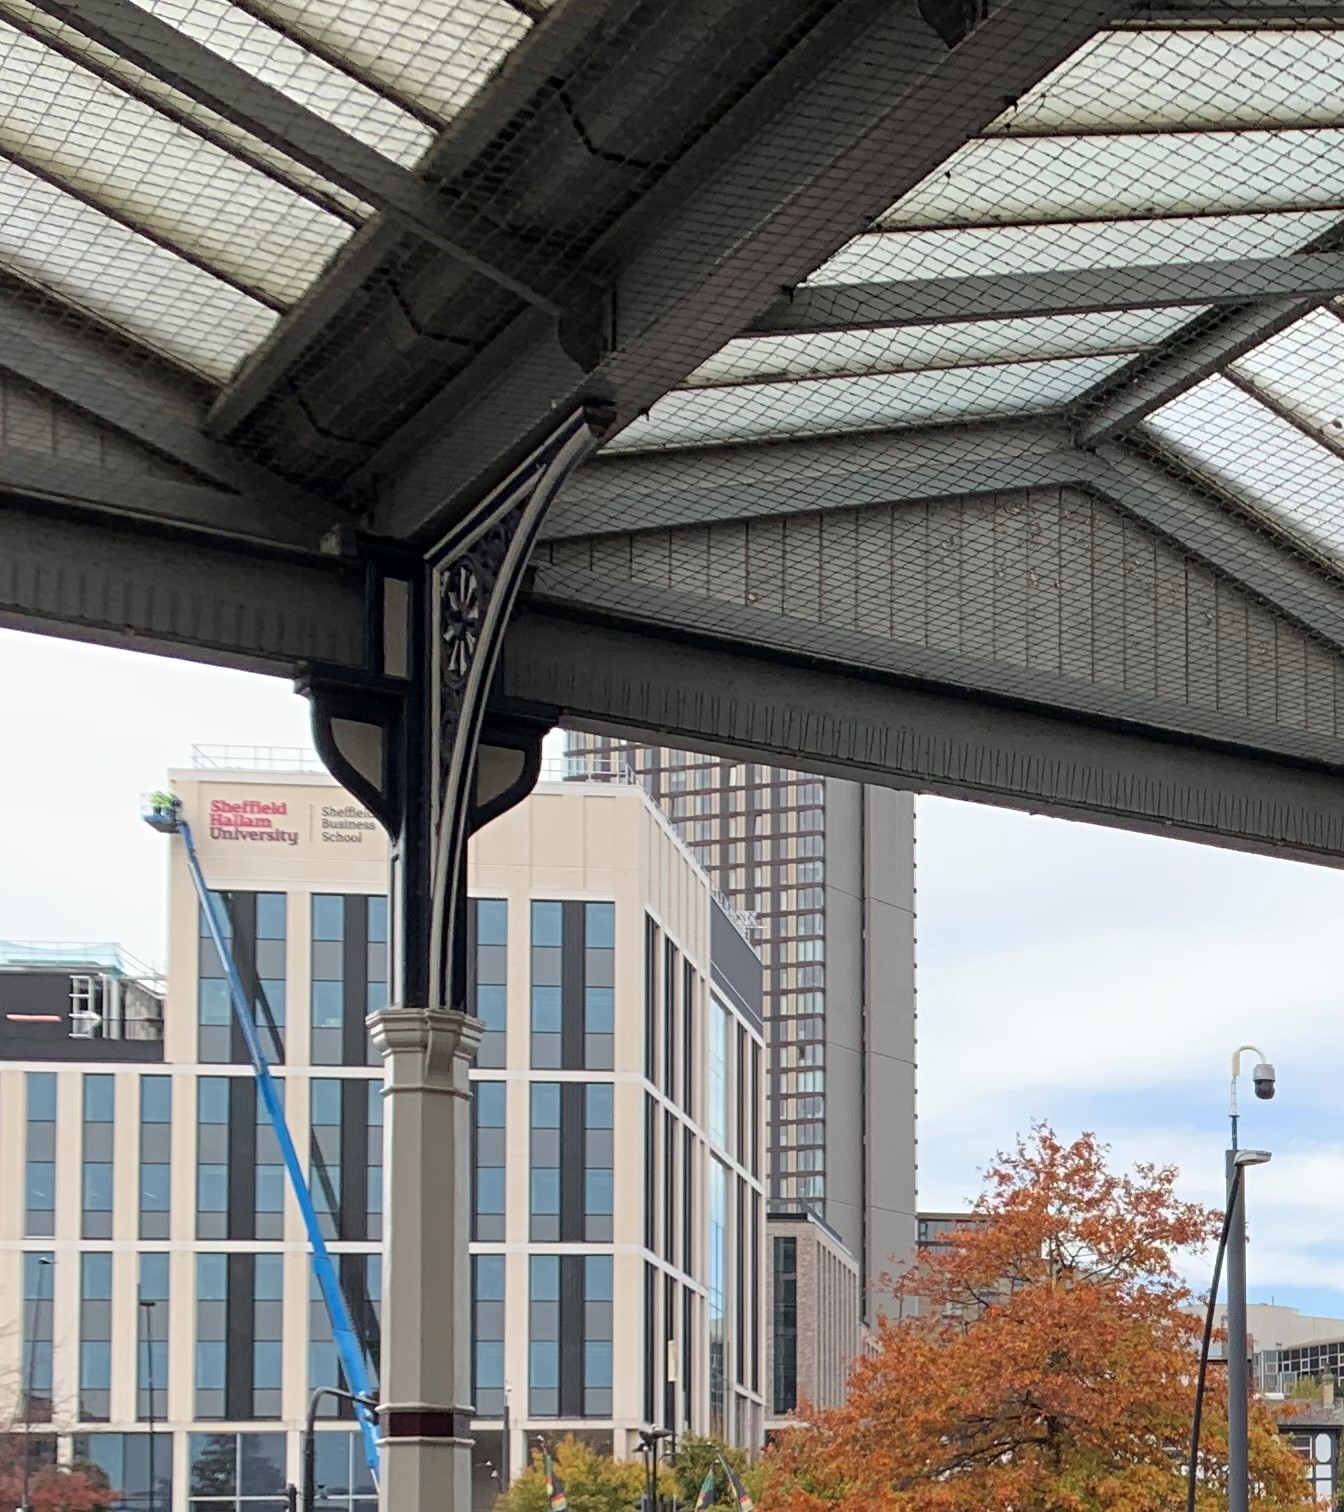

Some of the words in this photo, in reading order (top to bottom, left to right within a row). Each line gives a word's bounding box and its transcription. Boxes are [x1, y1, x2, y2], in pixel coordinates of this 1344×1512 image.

[210, 800, 287, 815] Sheffield
[210, 813, 272, 828] Hallam
[321, 818, 376, 830] Business
[210, 827, 298, 845] University
[321, 831, 362, 843] School
